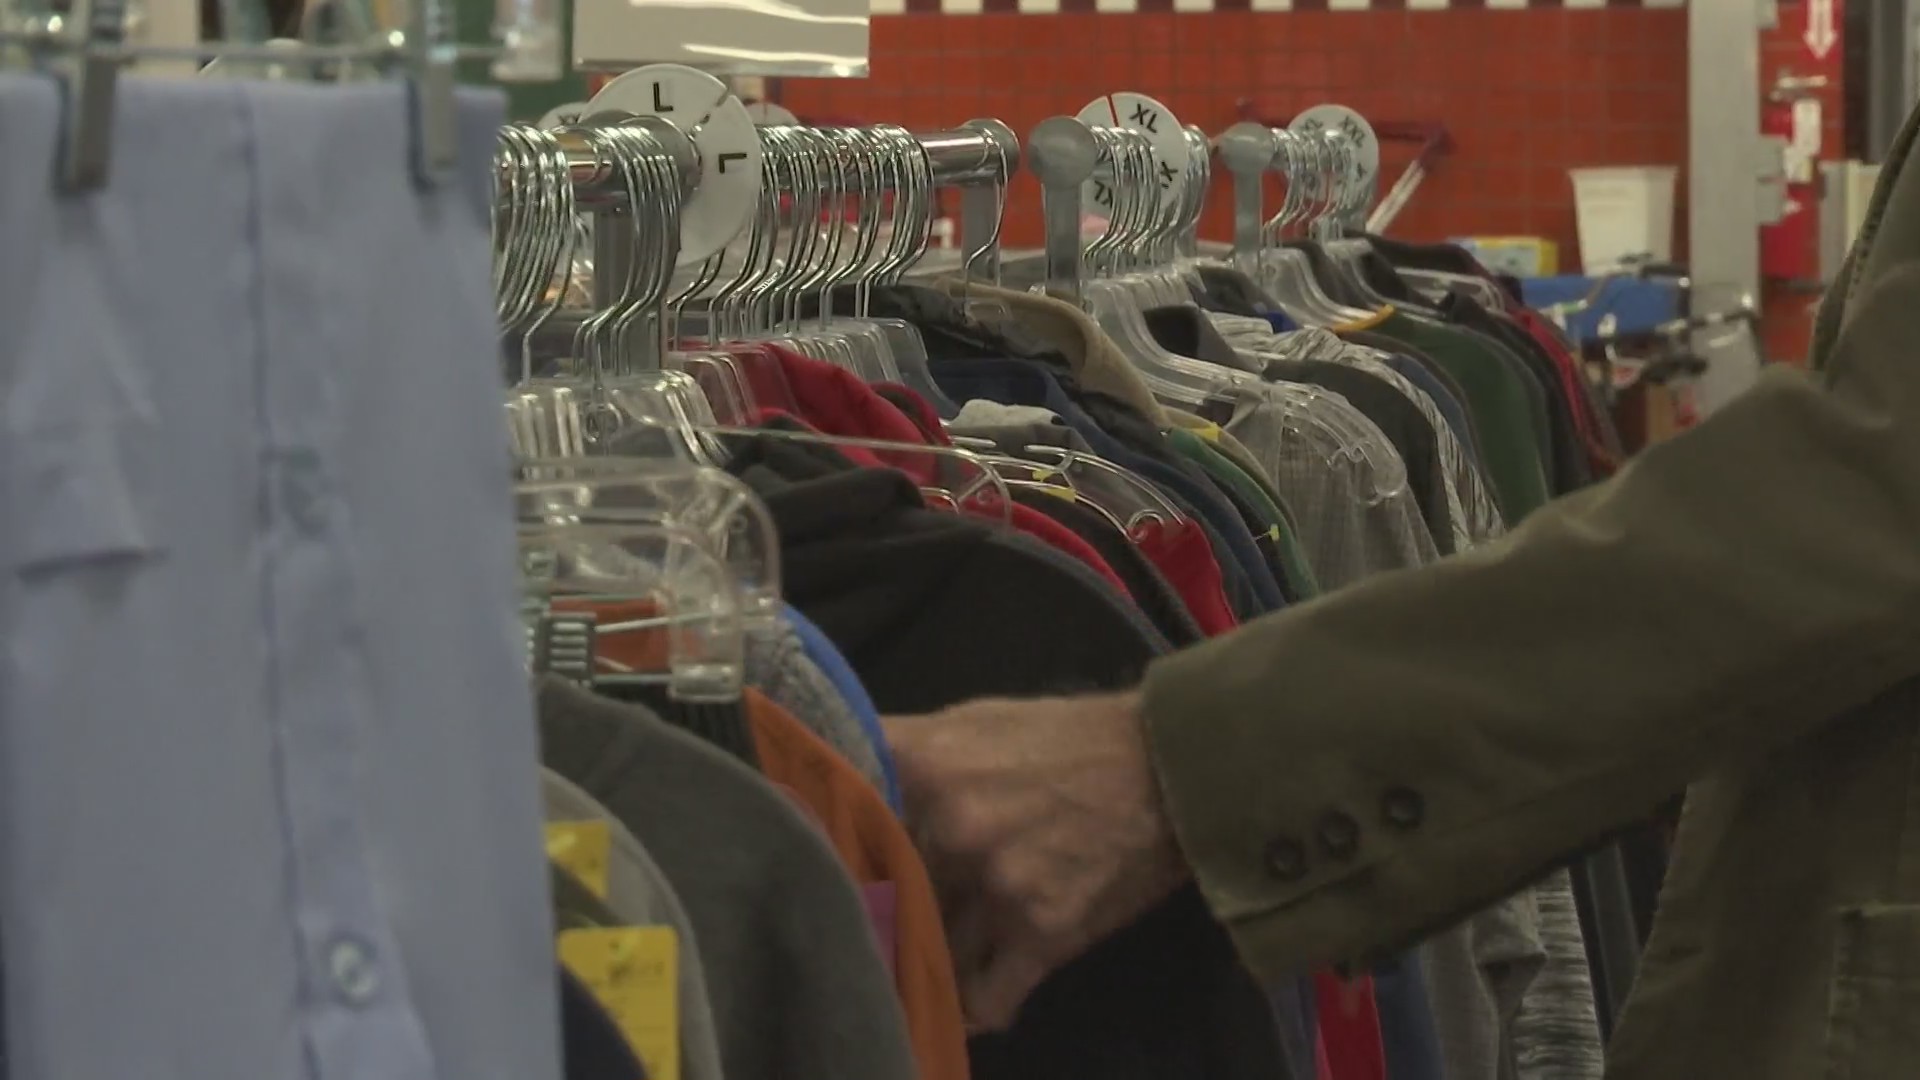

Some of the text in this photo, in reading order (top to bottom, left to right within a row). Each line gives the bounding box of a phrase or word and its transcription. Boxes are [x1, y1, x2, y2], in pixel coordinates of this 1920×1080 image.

[653, 82, 674, 113] L
[1129, 103, 1158, 134] XL
[718, 152, 747, 174] L
